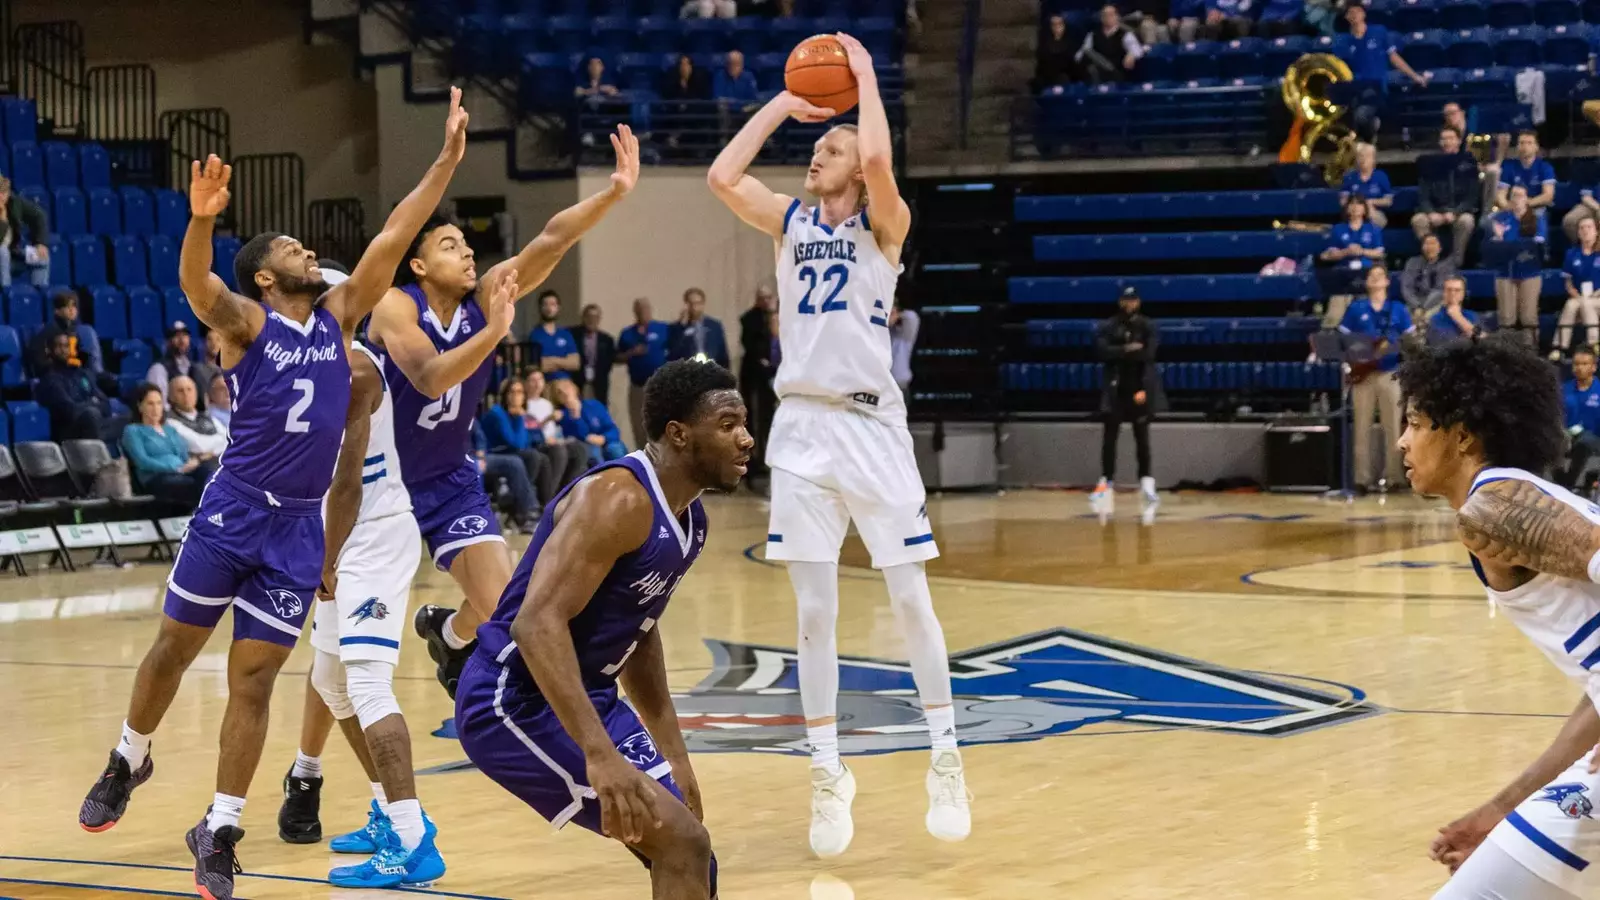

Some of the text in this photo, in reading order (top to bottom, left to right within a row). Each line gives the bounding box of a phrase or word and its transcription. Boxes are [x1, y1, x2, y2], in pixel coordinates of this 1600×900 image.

[798, 264, 848, 314] 22
[264, 340, 302, 372] High
[285, 378, 315, 433] 2
